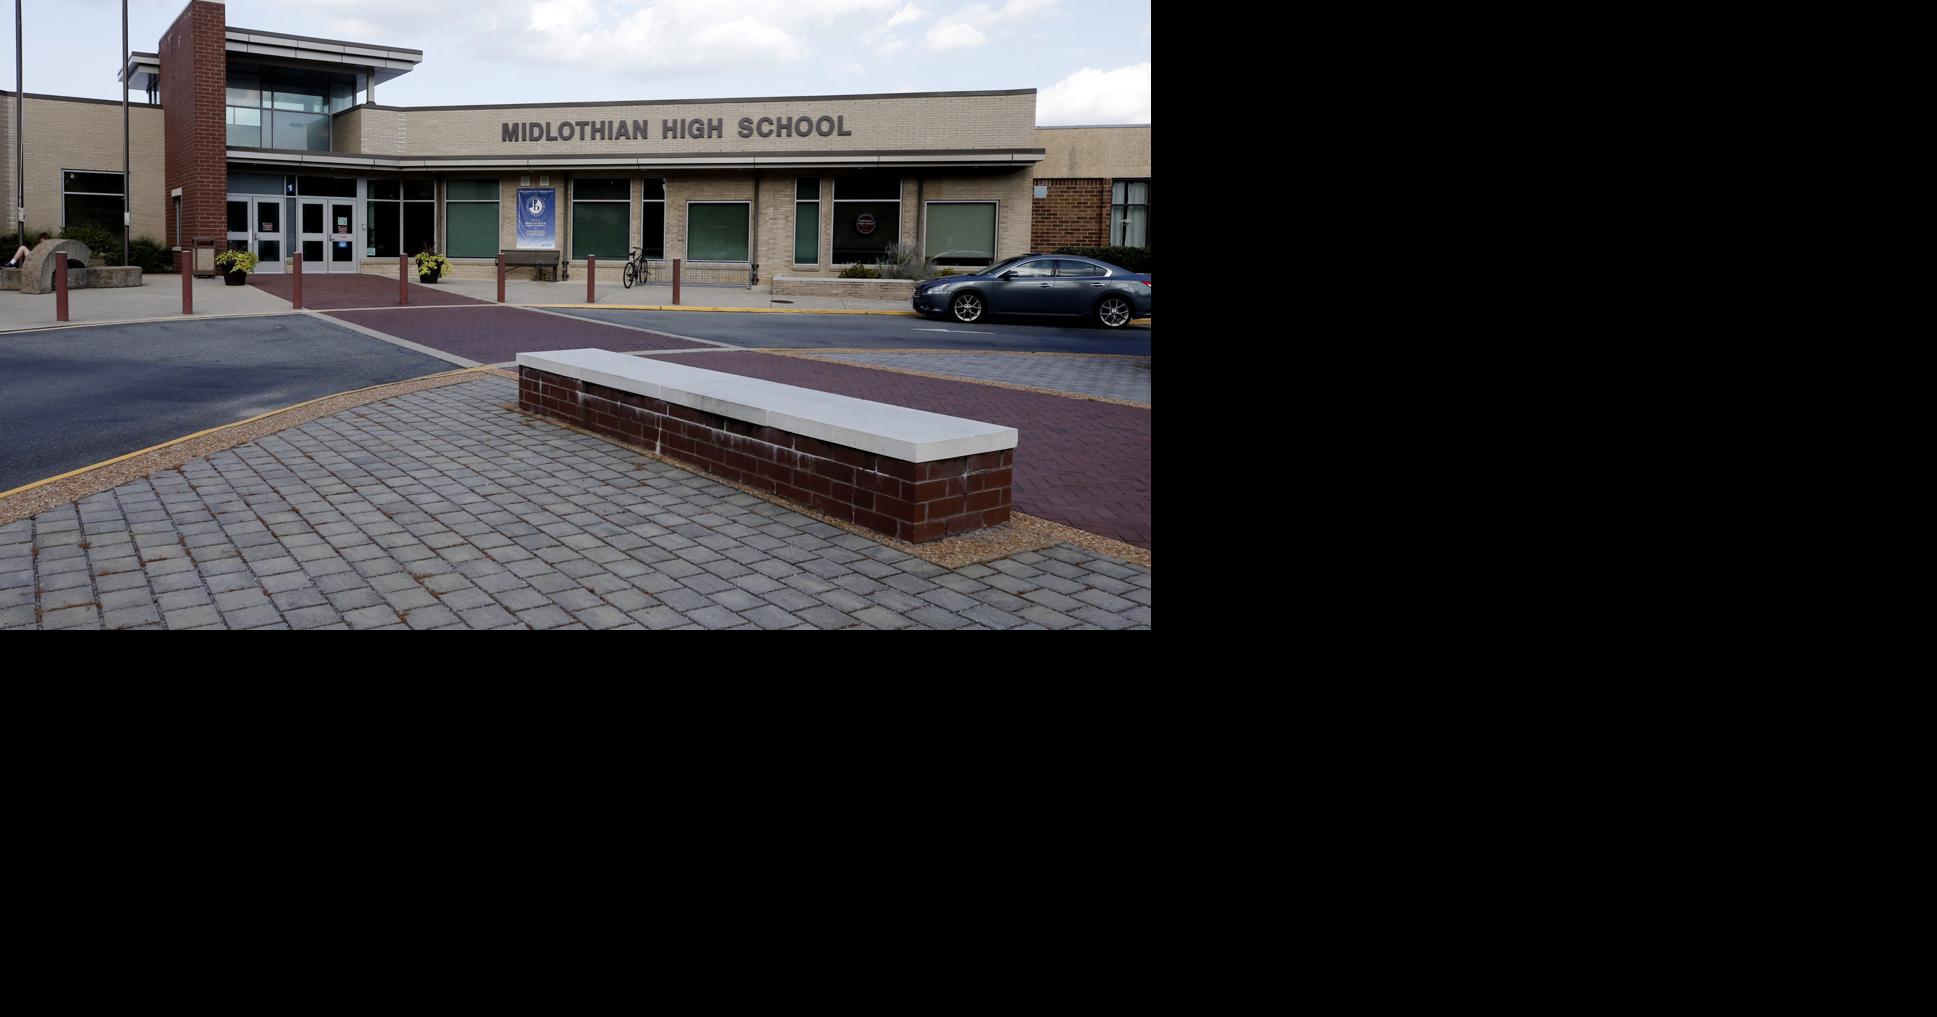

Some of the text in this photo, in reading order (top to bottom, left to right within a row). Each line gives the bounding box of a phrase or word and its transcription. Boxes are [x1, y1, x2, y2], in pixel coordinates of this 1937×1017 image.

[501, 115, 852, 142] MIDLOTHIAN HIGH SCHOOL
